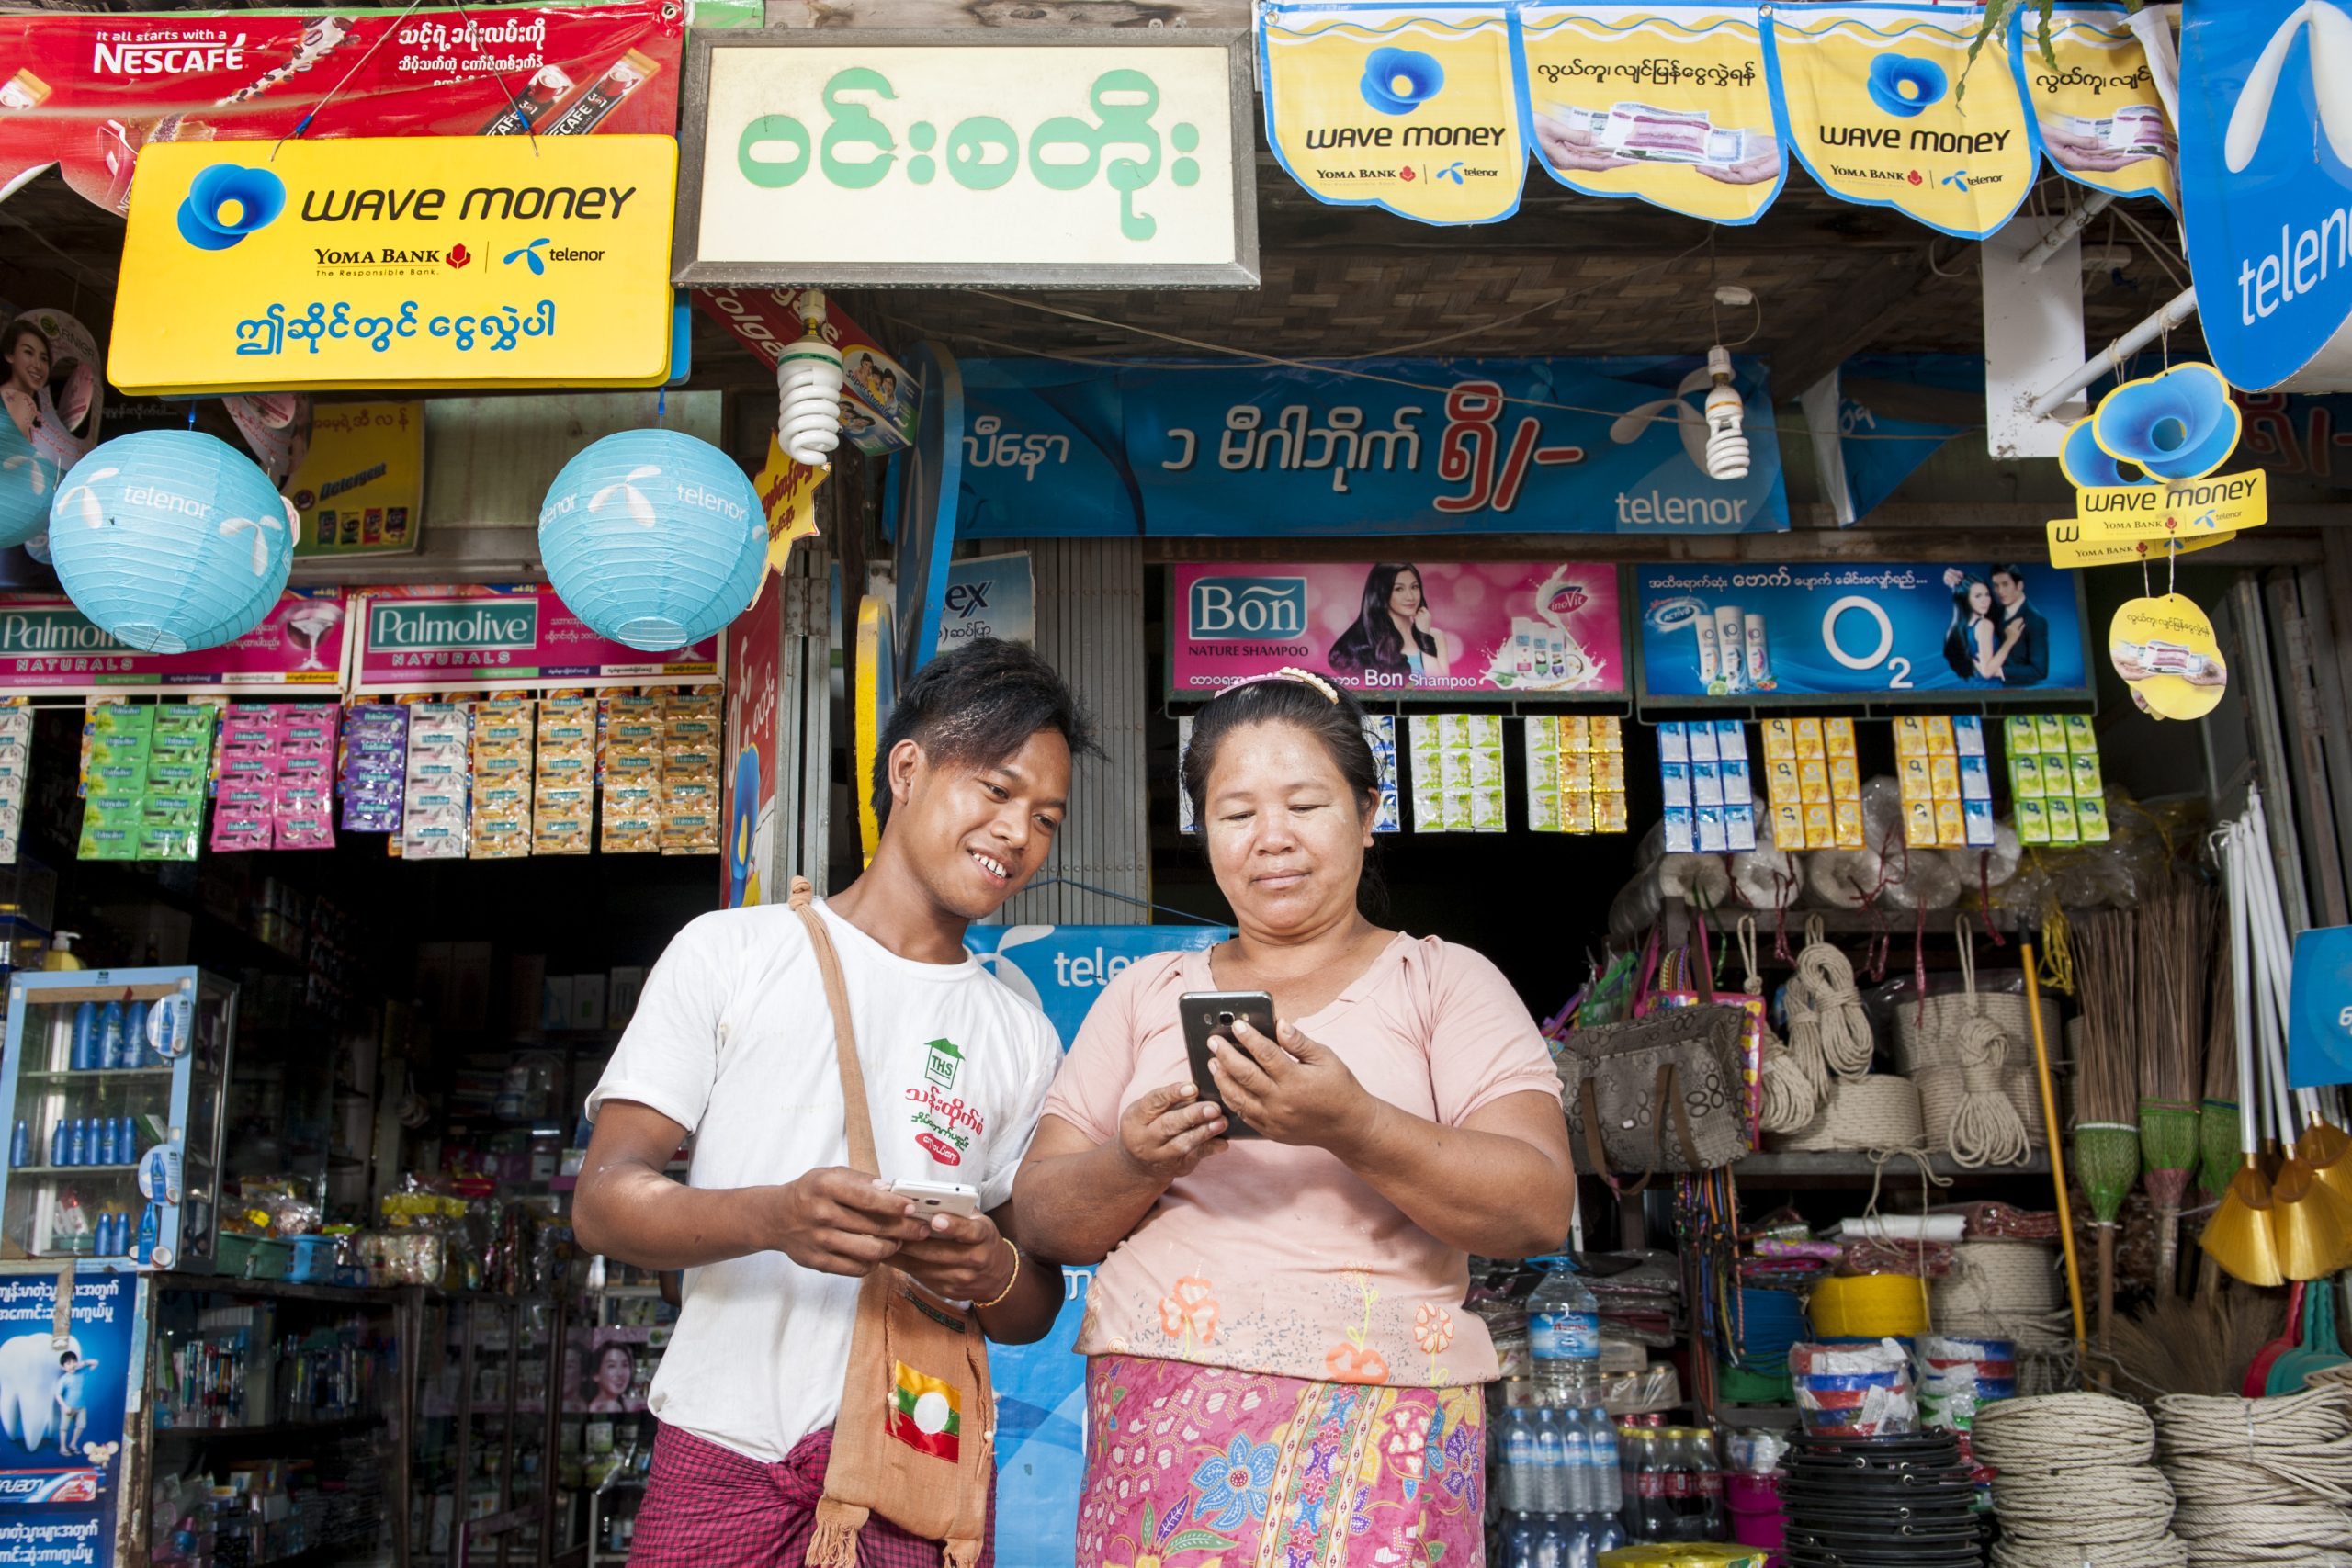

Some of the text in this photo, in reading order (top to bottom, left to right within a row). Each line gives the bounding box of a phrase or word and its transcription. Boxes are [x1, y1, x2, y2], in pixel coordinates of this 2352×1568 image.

[96, 29, 227, 42] It all starts with a
[1316, 168, 1396, 181] YOMA BANK
[1464, 166, 1499, 179] telenor
[1830, 164, 1905, 182] YOMA BANK
[1966, 174, 2004, 186] telenor
[315, 248, 440, 265] YOMA BANK
[549, 248, 605, 263] telenor
[316, 269, 335, 277] The
[339, 268, 405, 277] Responsible
[2238, 204, 2352, 326] telen
[124, 484, 211, 520] telenor
[677, 482, 747, 522] telenor
[1615, 489, 1747, 525] telenor
[2134, 520, 2163, 529] BANK
[378, 610, 528, 644] Palmolive
[391, 651, 511, 666] NATURALS
[1188, 644, 1309, 657] NATURE SHAMPOO
[17, 658, 133, 671] NATURALS
[1364, 671, 1403, 687] Bon
[1408, 673, 1477, 689] Shampoo
[1054, 946, 1141, 987] tele
[931, 1055, 954, 1077] THS
